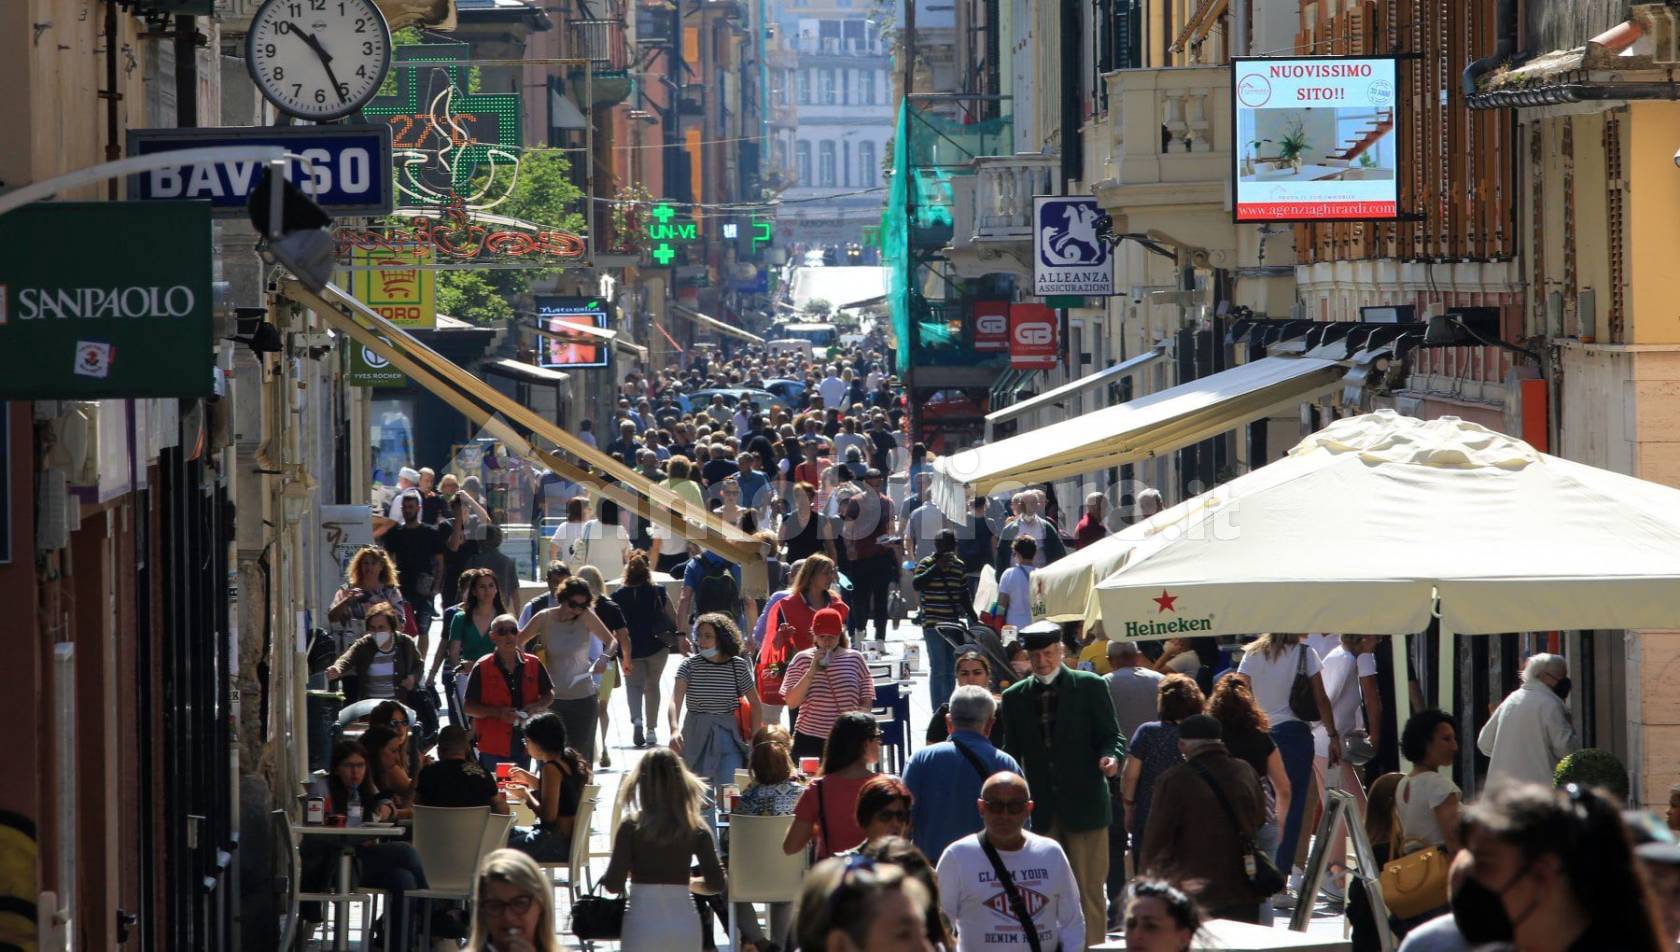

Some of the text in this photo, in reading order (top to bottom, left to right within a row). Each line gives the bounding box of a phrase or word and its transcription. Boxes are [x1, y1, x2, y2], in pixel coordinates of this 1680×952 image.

[288, 3, 302, 18] 11
[310, 0, 326, 10] 12
[337, 2, 345, 17] 1
[271, 20, 290, 35] 10
[354, 18, 366, 33] 2
[265, 43, 276, 58] 9
[362, 41, 373, 56] 3
[273, 66, 284, 81] 8
[355, 64, 367, 79] 4
[1270, 64, 1372, 78] NUOVISSIMO
[291, 83, 303, 98] 7
[314, 89, 326, 104] 6
[340, 82, 350, 97] 5
[1297, 87, 1345, 101] SITO!!
[151, 148, 370, 198] BAVSO
[1239, 203, 1396, 217] www.agenziaghirardi.com
[1039, 272, 1109, 283] ALLEANZA
[1039, 284, 1109, 292] ASSICURAZIONI
[18, 285, 195, 320] SANPAOLO
[369, 307, 421, 319] ORO
[1014, 322, 1053, 345] GB
[1125, 617, 1212, 637] Heineken
[1020, 868, 1049, 880] YOUR
